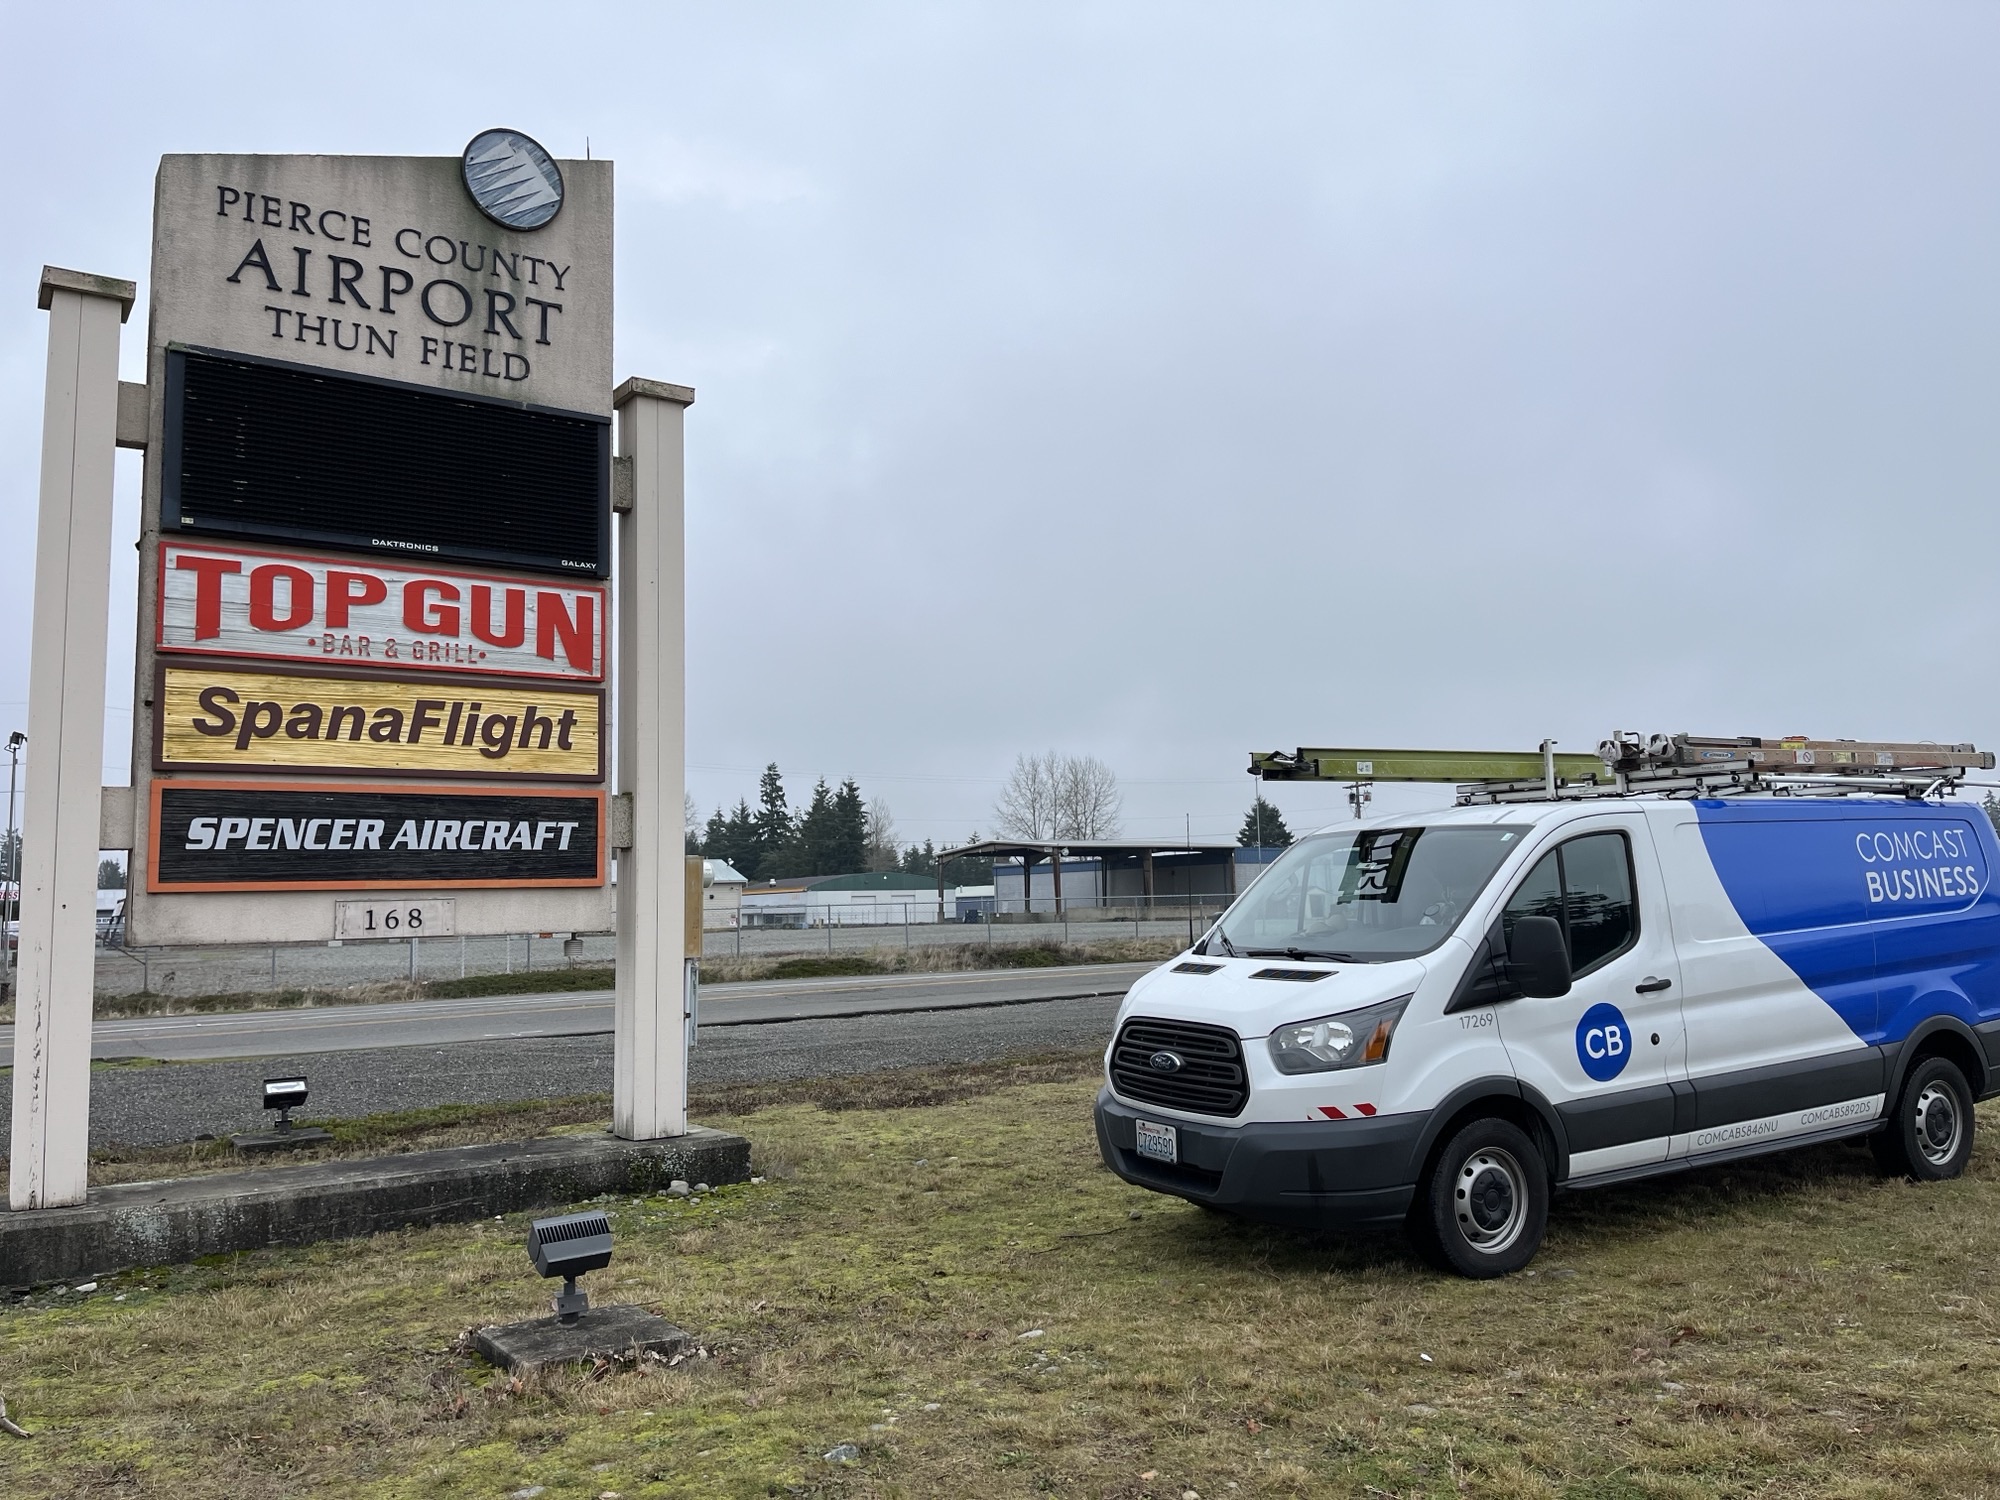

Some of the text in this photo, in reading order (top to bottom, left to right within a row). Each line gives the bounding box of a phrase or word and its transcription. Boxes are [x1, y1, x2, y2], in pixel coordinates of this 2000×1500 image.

[217, 185, 571, 291] PIERCE COUNTY
[227, 238, 563, 345] AIRPORT
[264, 305, 531, 382] THUN FIELD
[371, 538, 439, 552] DAKTRONICS
[561, 559, 597, 569] GALAXY
[175, 555, 594, 675] TOP GUN
[322, 633, 477, 664] BAR & GRILL
[192, 686, 577, 759] SpanaFlight
[185, 817, 579, 851] SPENCER AIRCRAFT
[1856, 829, 1968, 863] COMCAST
[1865, 866, 1979, 903] BUSINESS
[365, 908, 423, 931] 168
[1459, 1013, 1493, 1029] 17269
[1585, 1025, 1624, 1059] CB
[1801, 1101, 1871, 1125] COMCABS892DS
[1697, 1120, 1779, 1146] COMCABS846NU
